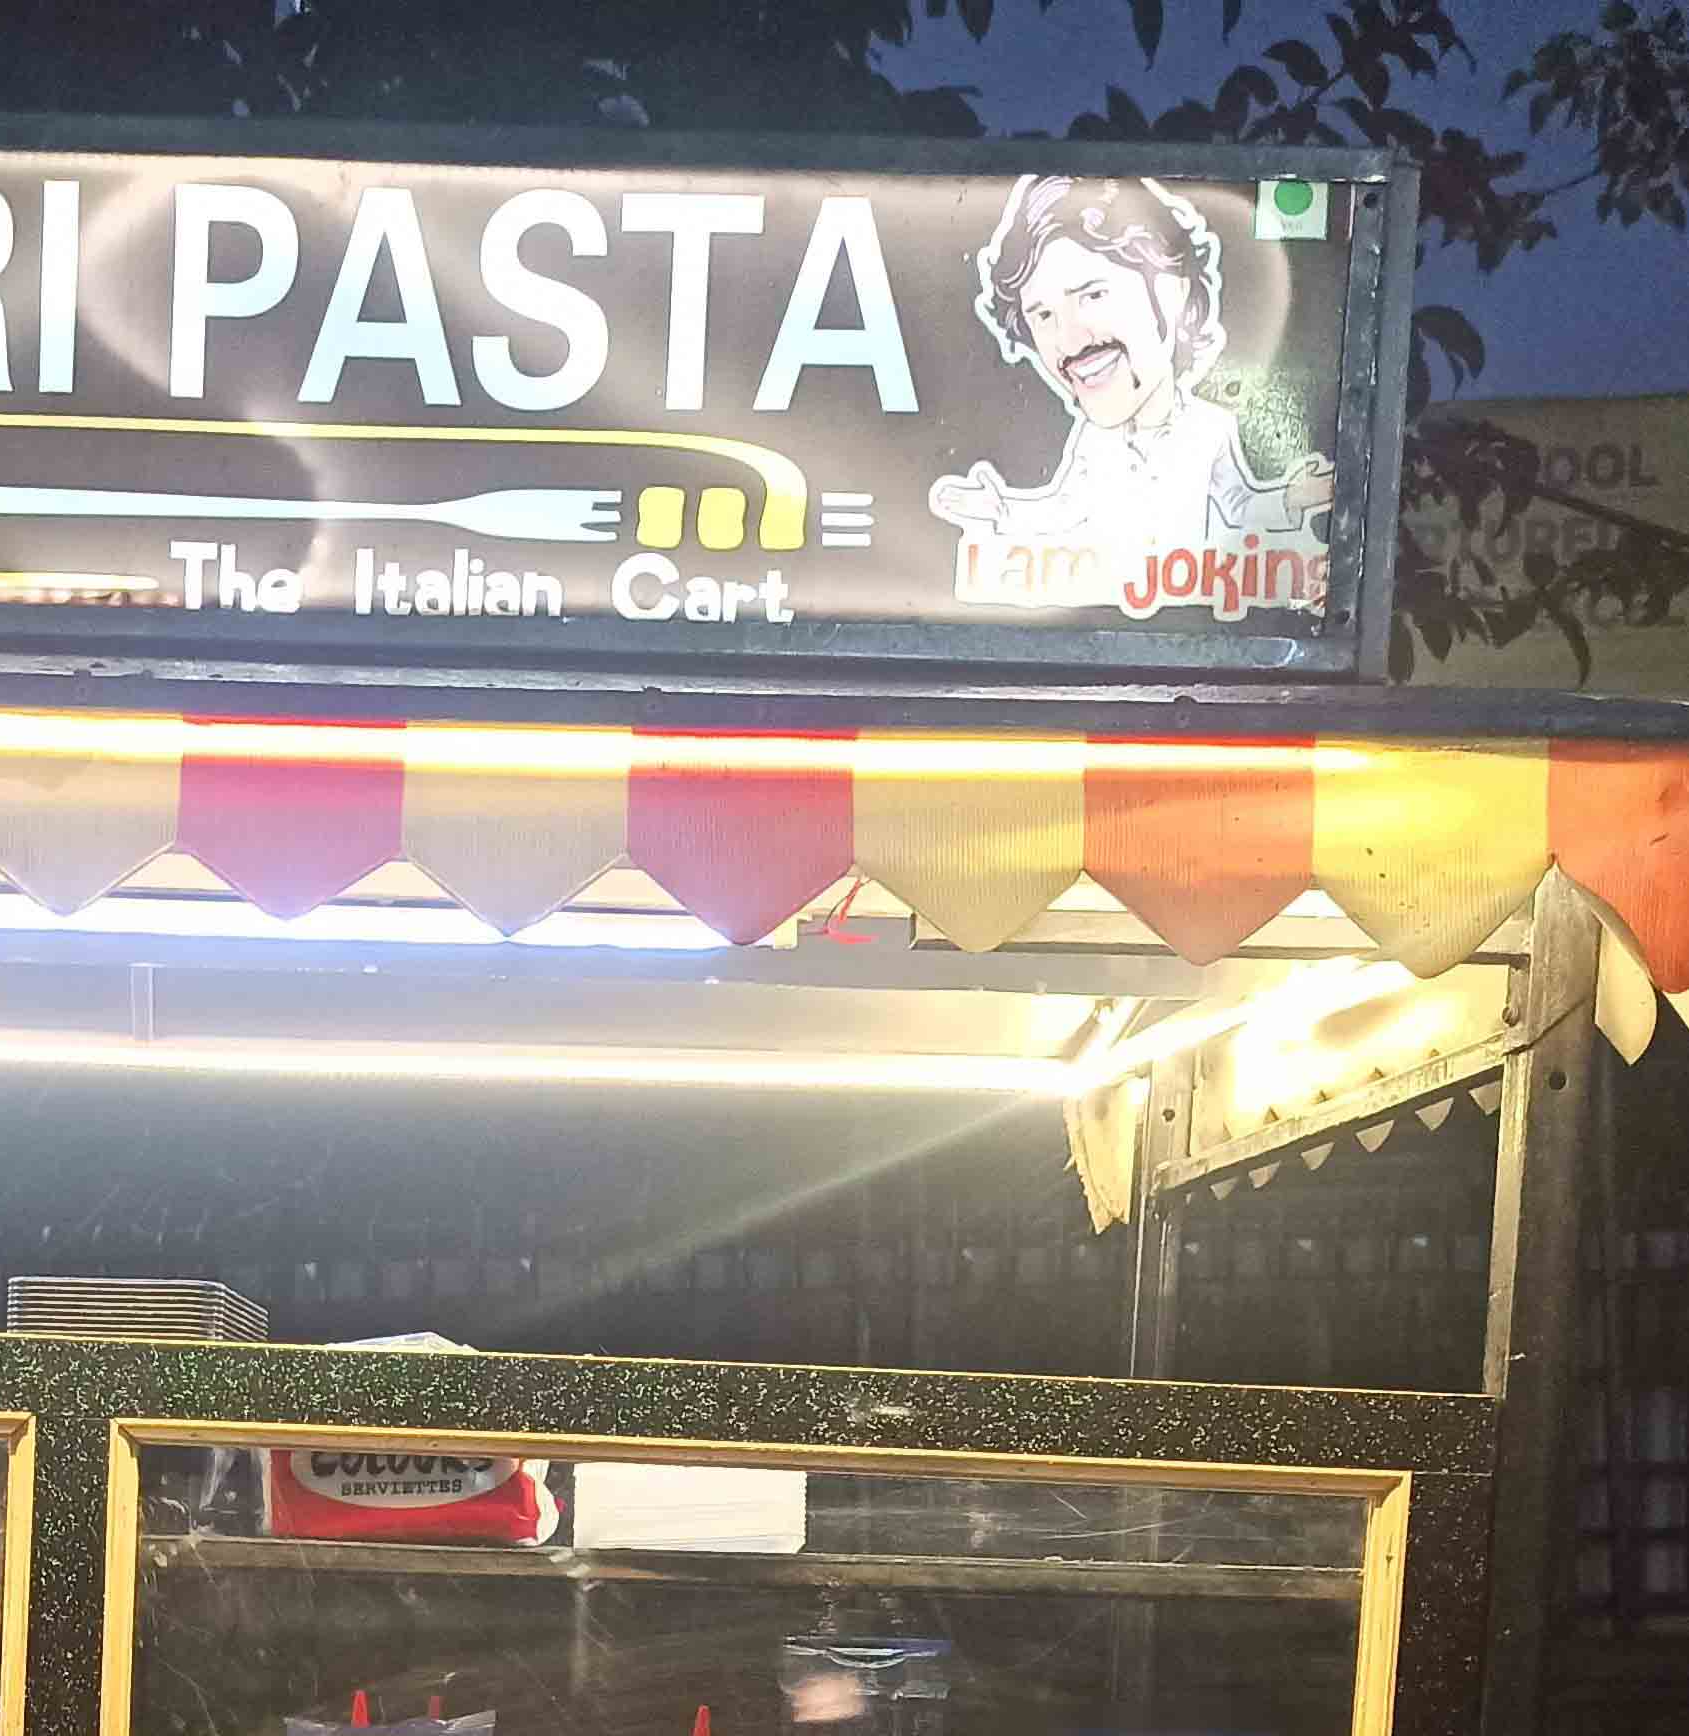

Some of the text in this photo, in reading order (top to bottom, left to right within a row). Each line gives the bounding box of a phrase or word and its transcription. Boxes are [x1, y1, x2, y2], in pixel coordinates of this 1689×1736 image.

[168, 183, 920, 413] PASTA
[169, 540, 795, 623] The Italian Cart
[340, 1478, 463, 1497] SERVIETTES
